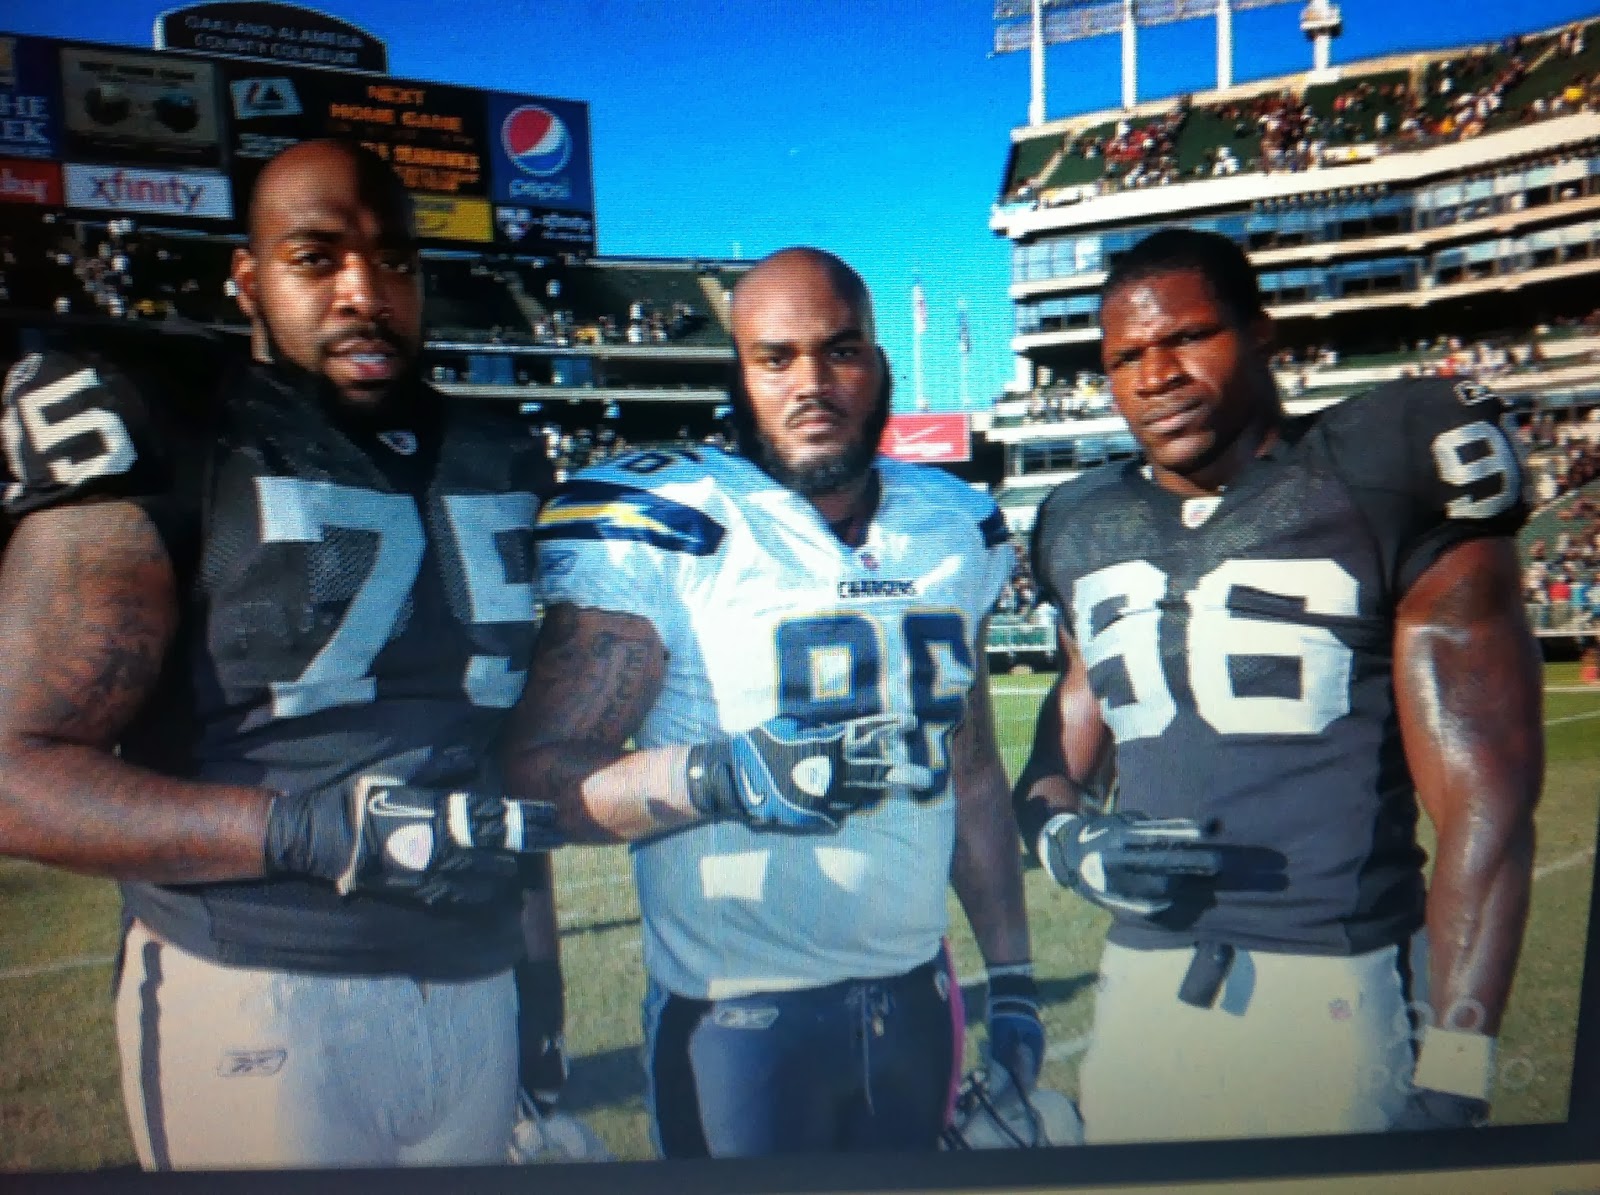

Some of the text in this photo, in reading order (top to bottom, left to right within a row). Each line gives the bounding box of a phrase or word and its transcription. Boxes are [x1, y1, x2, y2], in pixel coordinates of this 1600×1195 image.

[367, 85, 426, 106] NEXT
[330, 103, 463, 133] HOME GAME
[90, 169, 206, 212] xfinity
[509, 179, 571, 201] pepsi
[1430, 420, 1521, 519] 9
[253, 475, 541, 720] 75
